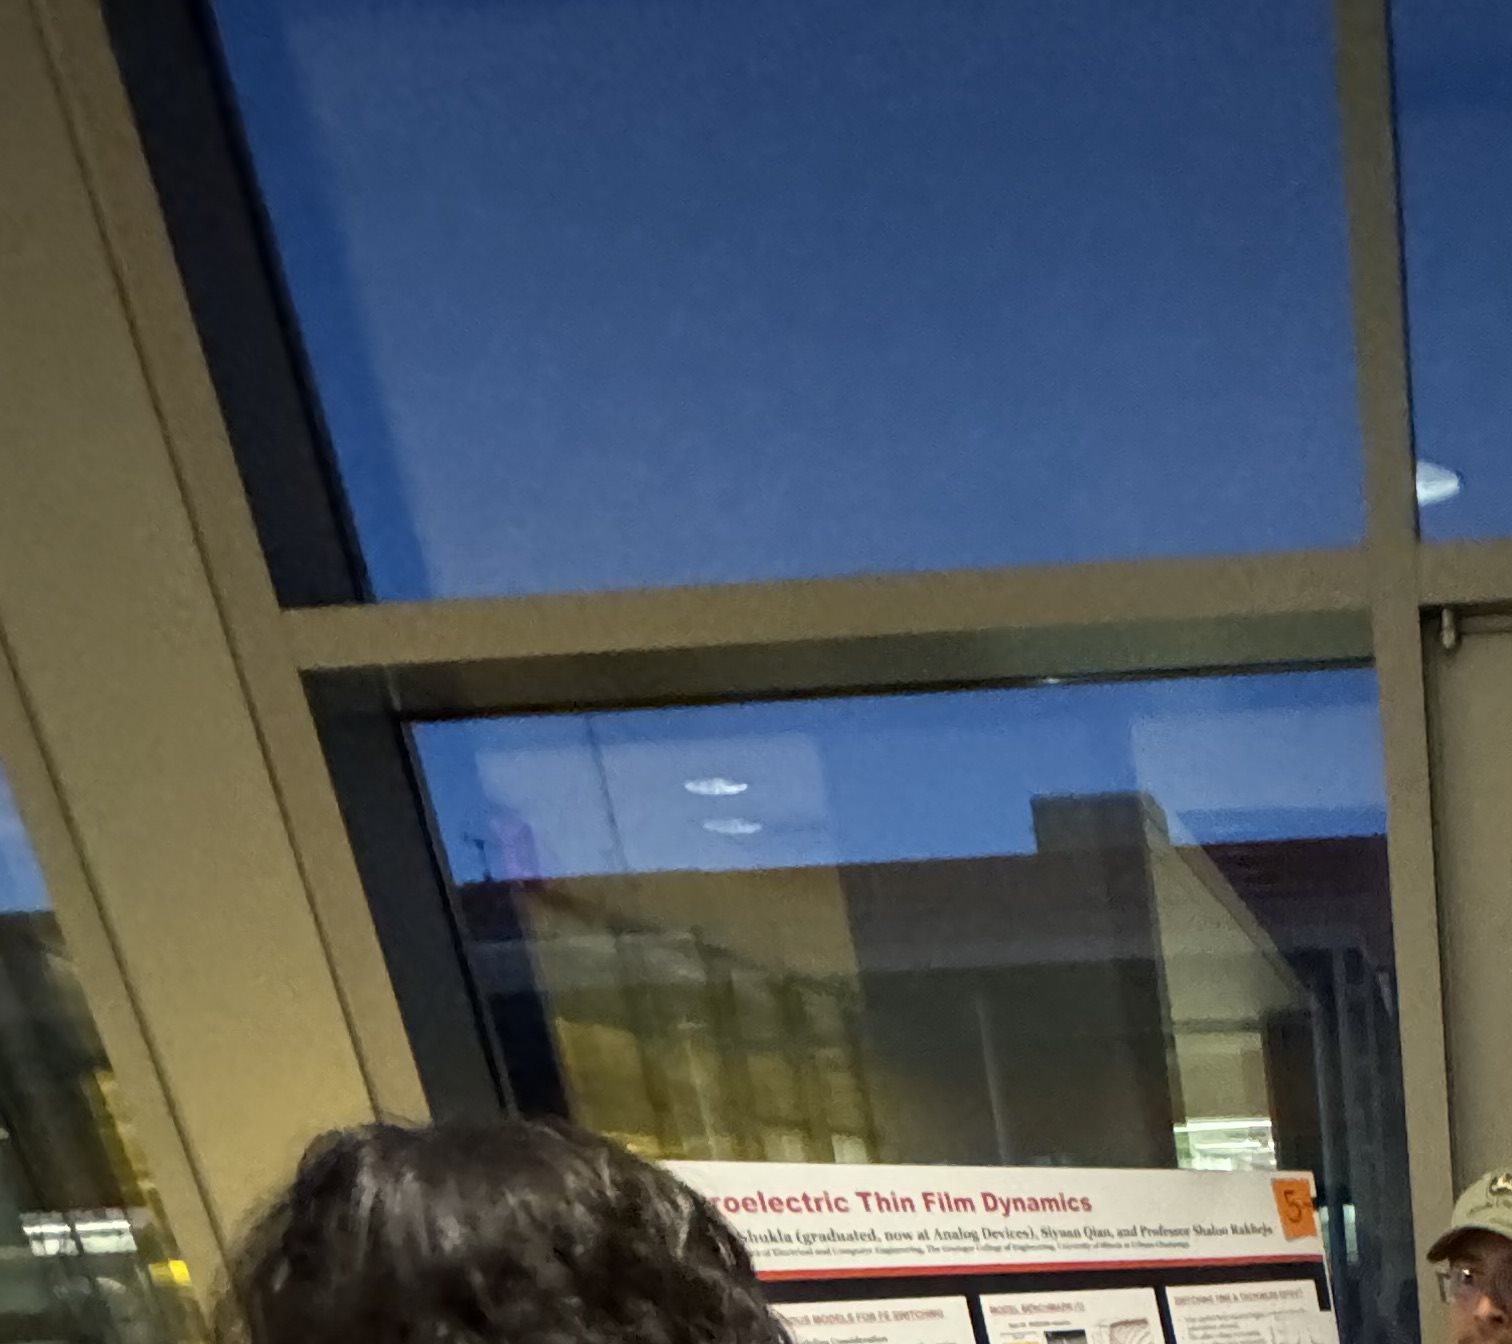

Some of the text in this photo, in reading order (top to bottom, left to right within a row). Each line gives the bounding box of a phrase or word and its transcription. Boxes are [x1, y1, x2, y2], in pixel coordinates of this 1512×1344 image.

[855, 1190, 915, 1213] Thin
[921, 1191, 976, 1213] Film
[981, 1190, 1092, 1216] Dynamics
[795, 1227, 881, 1245] (graduated,
[884, 1231, 913, 1242] now
[917, 1229, 930, 1241] at
[933, 1226, 979, 1243] Analog
[1116, 1224, 1137, 1237] and
[1140, 1223, 1190, 1237] Professor
